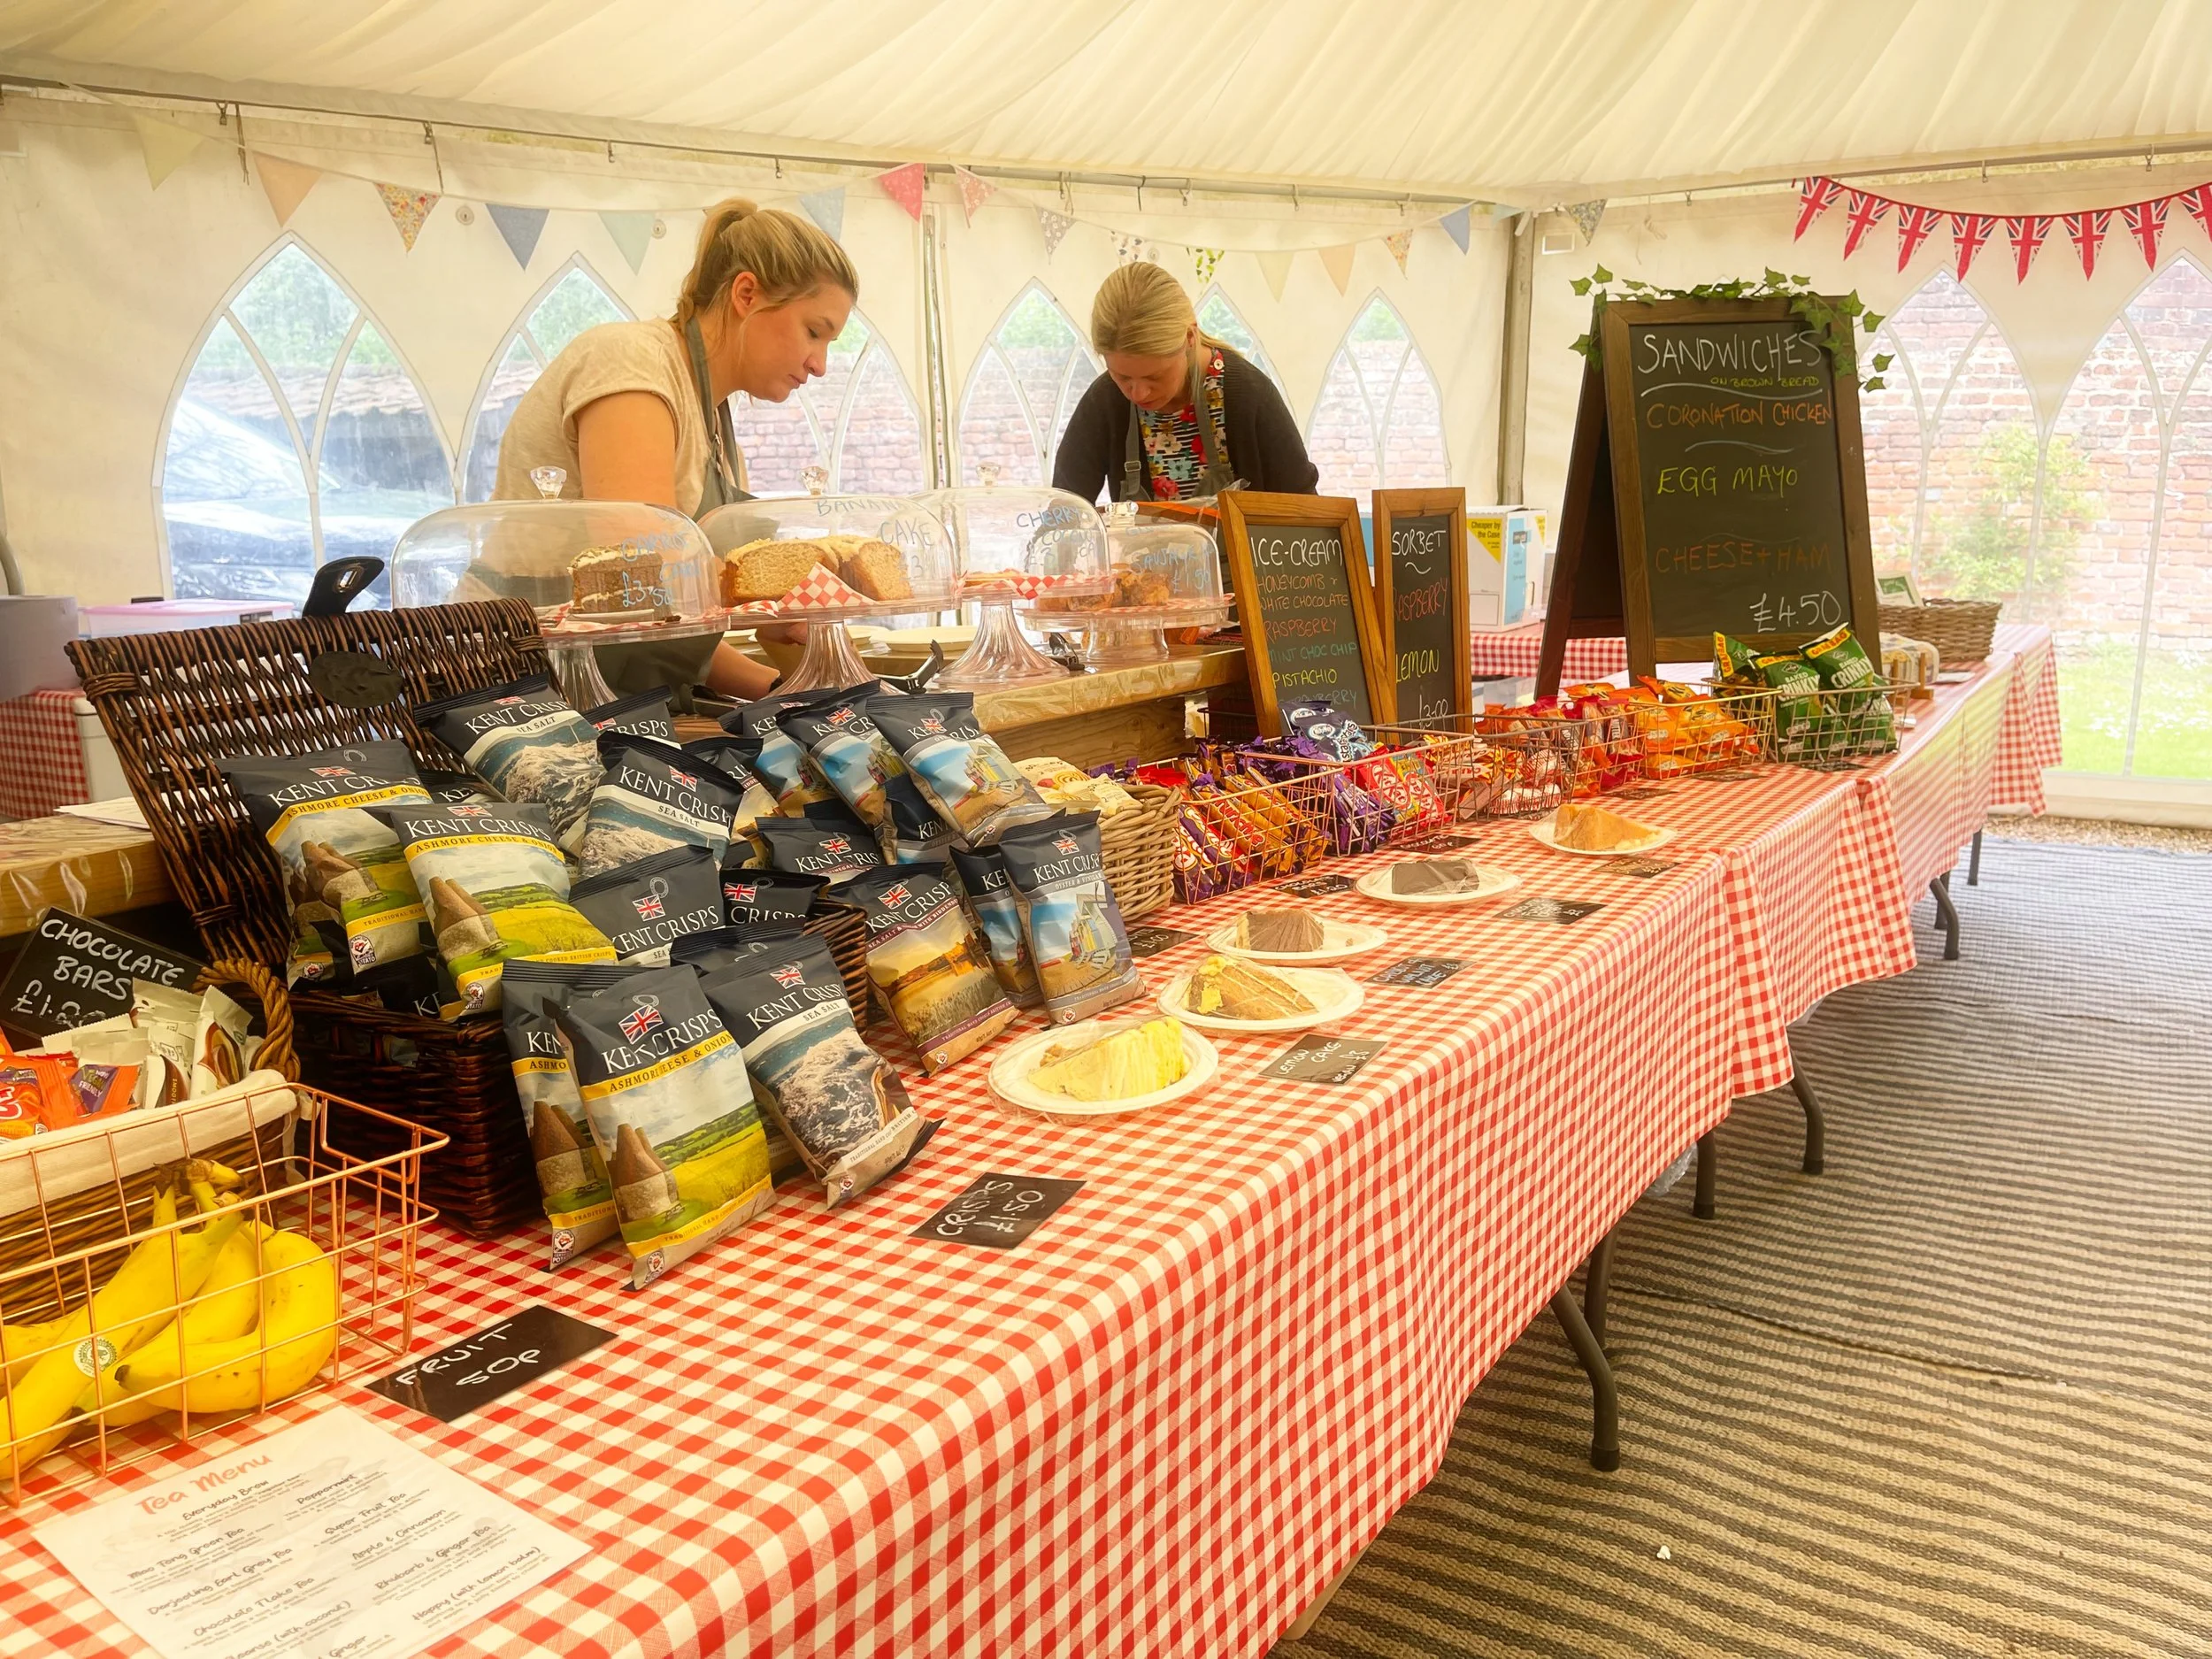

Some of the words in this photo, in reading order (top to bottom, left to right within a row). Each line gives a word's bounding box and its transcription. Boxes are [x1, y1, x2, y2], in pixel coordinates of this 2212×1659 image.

[1638, 330, 1823, 380] SANDWICHES
[1733, 377, 1773, 388] BROWN
[1779, 376, 1820, 387] BREAD
[1647, 400, 1763, 431] CORONATION
[1772, 389, 1832, 426] CHICKEN
[1657, 465, 1718, 497] EGG
[1732, 465, 1799, 498] MAYO
[880, 518, 934, 547] CAKE
[1391, 530, 1446, 557] SORBET
[1250, 536, 1344, 567] ICE-CREAM
[1776, 541, 1832, 574] HAM
[1256, 572, 1325, 595] HONEYCOMB
[1260, 595, 1290, 612] WHITE
[1293, 593, 1348, 609] CHOCOLATE
[1749, 590, 1841, 634] £4.50
[1263, 617, 1337, 643] RASPBERRY
[1830, 632, 1847, 646] BAG
[1300, 644, 1327, 662] CHOC
[1330, 641, 1358, 657] CHIP
[1272, 668, 1338, 689] PISTACHIO
[1395, 649, 1440, 684] LEMON
[1785, 672, 1809, 684] BAKED
[464, 707, 518, 736] KENT
[534, 716, 556, 730] SALT
[267, 779, 342, 809] KENT
[619, 766, 676, 802] KENT
[286, 799, 342, 821] ASHMORE
[343, 792, 387, 805] CHEESE
[657, 806, 677, 818] SEA
[679, 813, 701, 828] SALT
[404, 818, 472, 840] KENT
[479, 818, 552, 841] CRISPS
[415, 836, 474, 854] ASHMORE
[531, 840, 557, 855] ONION
[795, 852, 841, 873] KENT
[1033, 858, 1071, 884] KENT
[611, 926, 657, 956] KENT
[656, 904, 720, 941] CRISPS
[865, 910, 907, 933] KENT
[41, 918, 186, 987] CHOCOLATE
[868, 938, 881, 949] SEA
[880, 930, 896, 941] SALT
[653, 949, 666, 960] SEA
[53, 955, 133, 1002] BARS
[746, 991, 803, 1032] KENT
[803, 1010, 820, 1022] SEA
[823, 1002, 841, 1013] SALT
[651, 1008, 723, 1057] CRISPS
[694, 1048, 703, 1058] &
[704, 1033, 733, 1053] ONION
[529, 1061, 567, 1071] ASHMO
[1276, 1048, 1310, 1075] LEMON
[1310, 1041, 1343, 1064] CAKE
[936, 1180, 1015, 1237] CRISPS
[396, 1323, 513, 1386] FRUIT
[134, 1490, 189, 1516] Tea
[189, 1454, 273, 1493] Menu
[295, 1473, 358, 1506] Peppermint
[181, 1493, 239, 1522] Everyday
[237, 1479, 269, 1497] Brew
[324, 1516, 357, 1536] Super
[388, 1492, 408, 1503] Tea
[188, 1537, 225, 1557] Green
[226, 1527, 246, 1540] Tea
[351, 1540, 385, 1562] Apple
[395, 1508, 447, 1540] Cinnamon
[374, 1560, 426, 1591] Rhubarb
[434, 1534, 471, 1559] Ginger
[472, 1524, 492, 1539] Tea
[147, 1584, 215, 1617] Darjeeling
[213, 1571, 242, 1587] Earl
[242, 1556, 273, 1575] Grey
[273, 1548, 293, 1559] Tea
[192, 1606, 255, 1638] Chocolate
[295, 1577, 316, 1590] Tea
[303, 1599, 352, 1628] coconut)
[411, 1598, 450, 1622] Happy
[328, 1634, 367, 1659] Ginger
